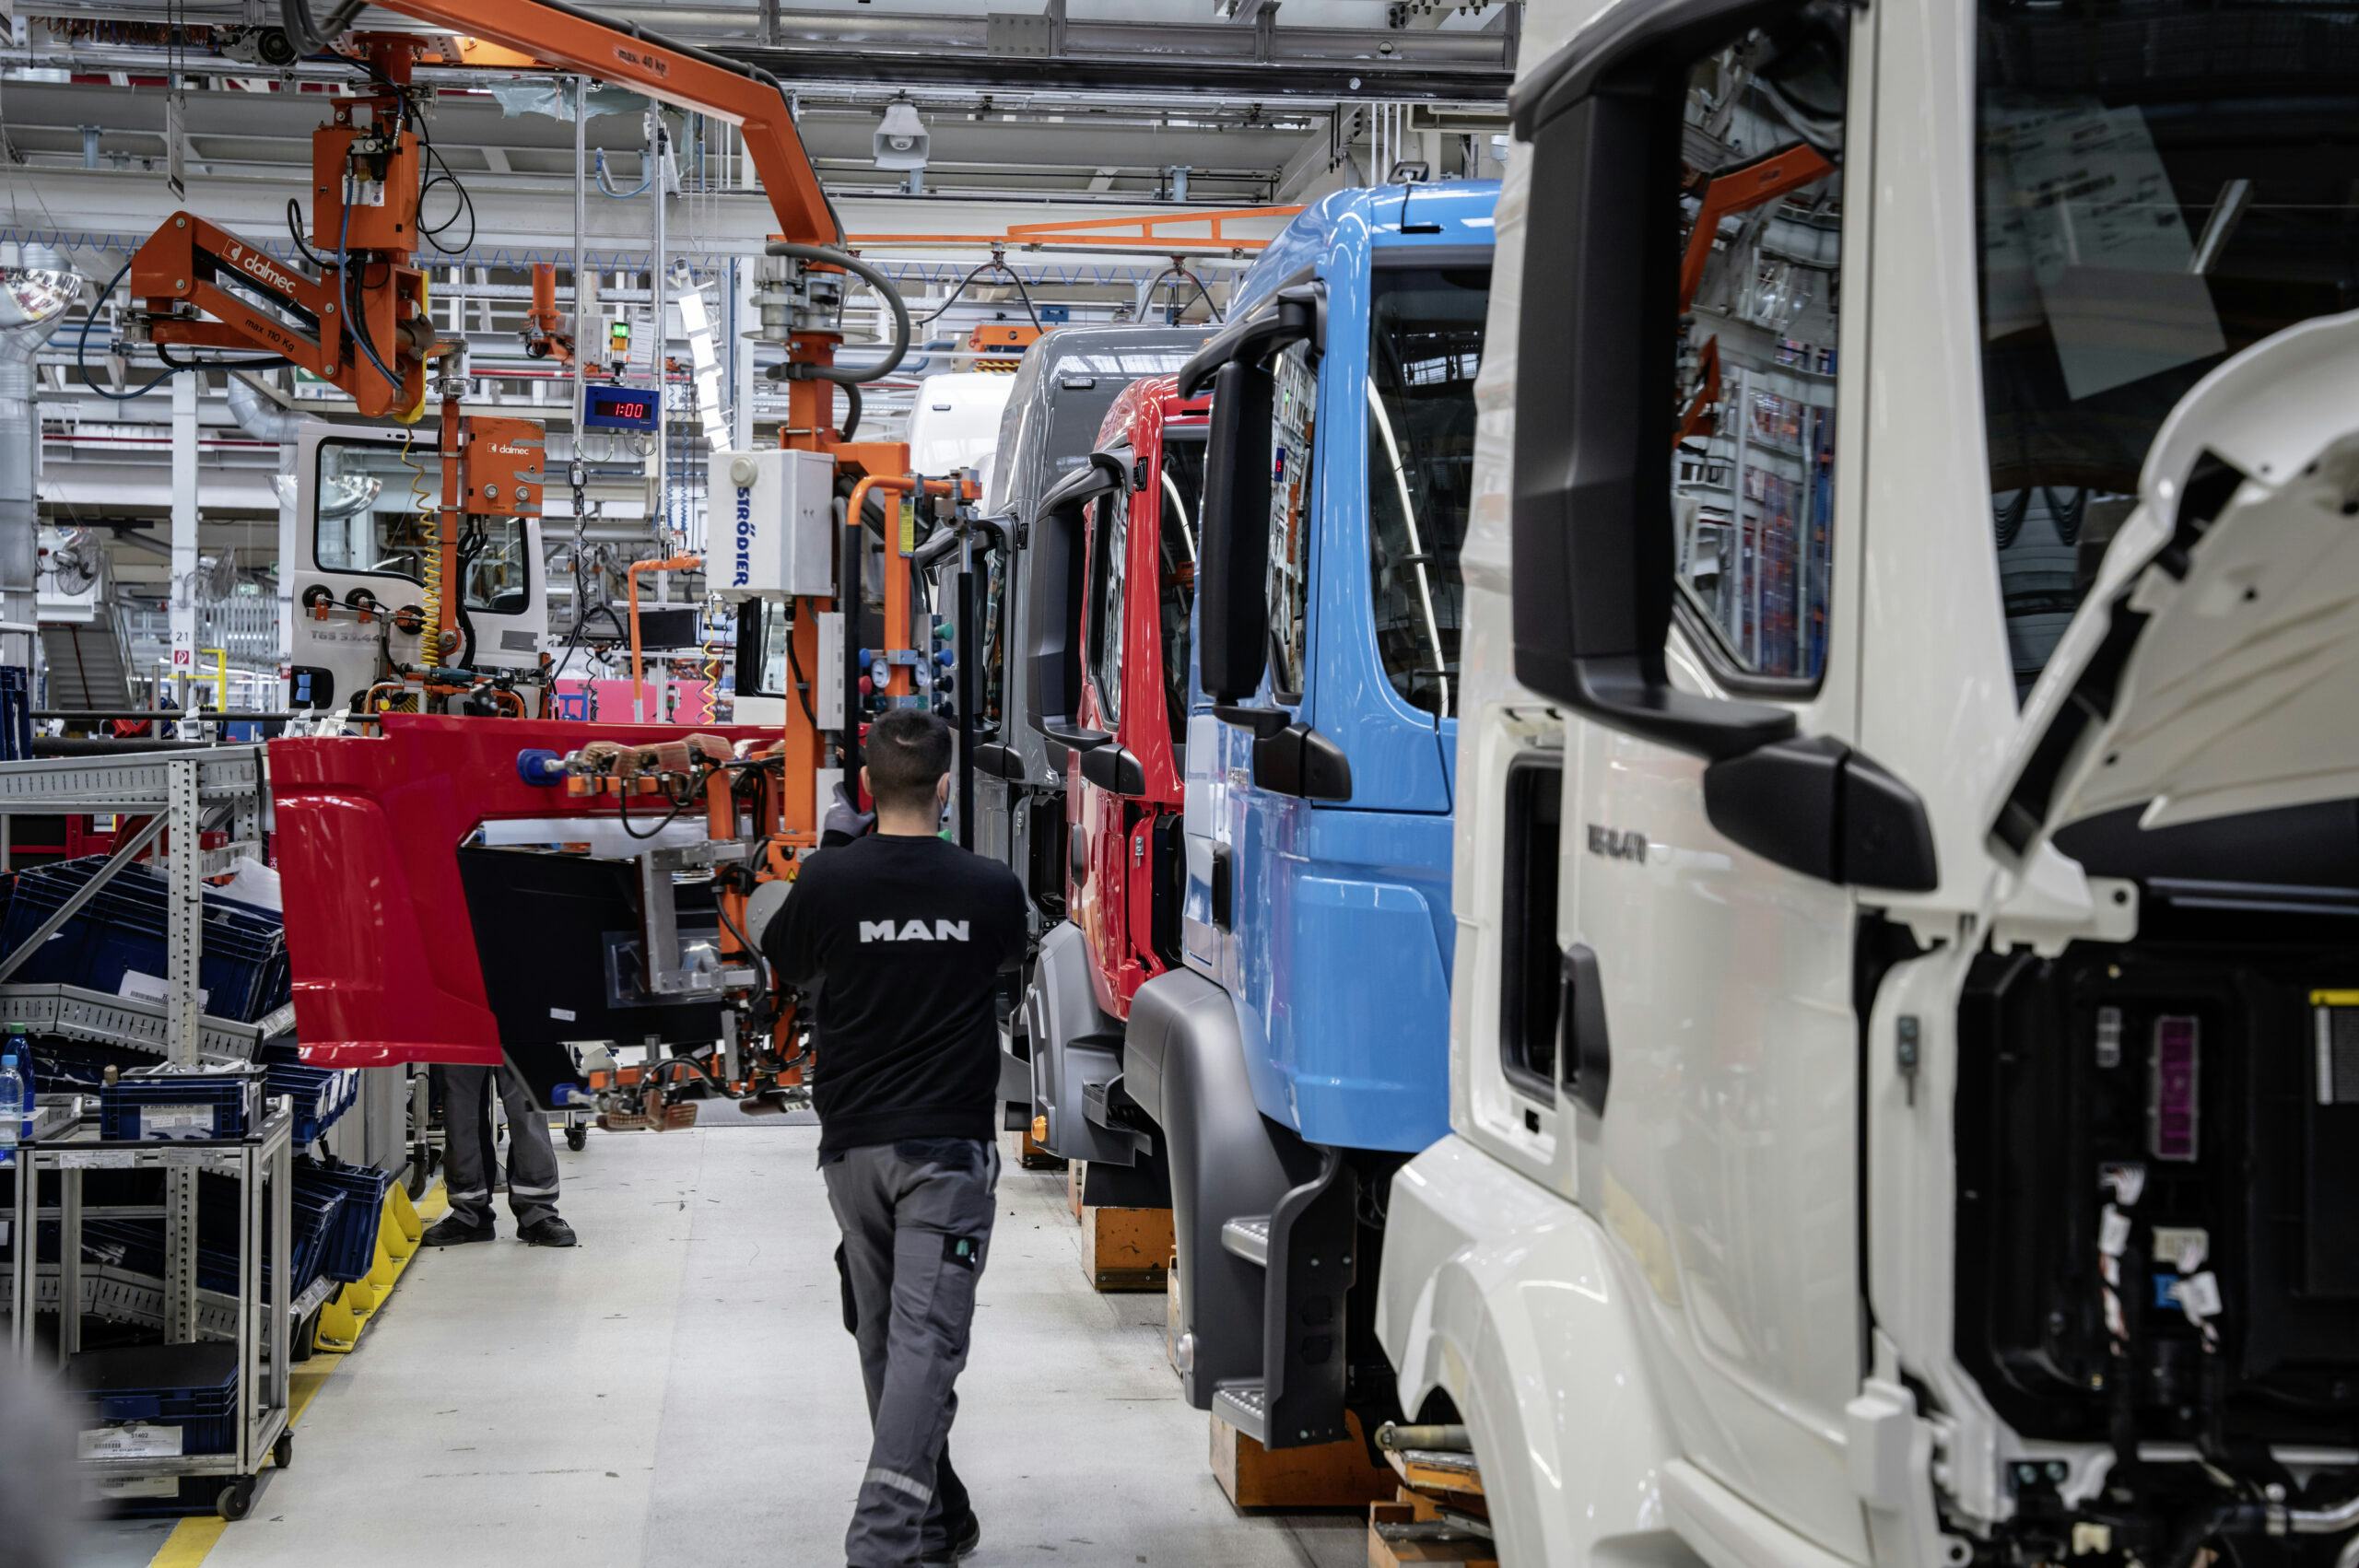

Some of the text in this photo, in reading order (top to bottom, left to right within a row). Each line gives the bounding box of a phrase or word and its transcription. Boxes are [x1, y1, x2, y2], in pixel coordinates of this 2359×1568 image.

[244, 254, 296, 294] dalmec
[245, 318, 264, 334] max
[267, 329, 281, 343] 110
[616, 403, 643, 418] 1:00
[499, 444, 530, 455] dalmec
[733, 486, 757, 588] STRÖDTER
[176, 631, 189, 642] 21
[311, 629, 380, 643] TGS 33.44
[859, 919, 969, 942] MAN
